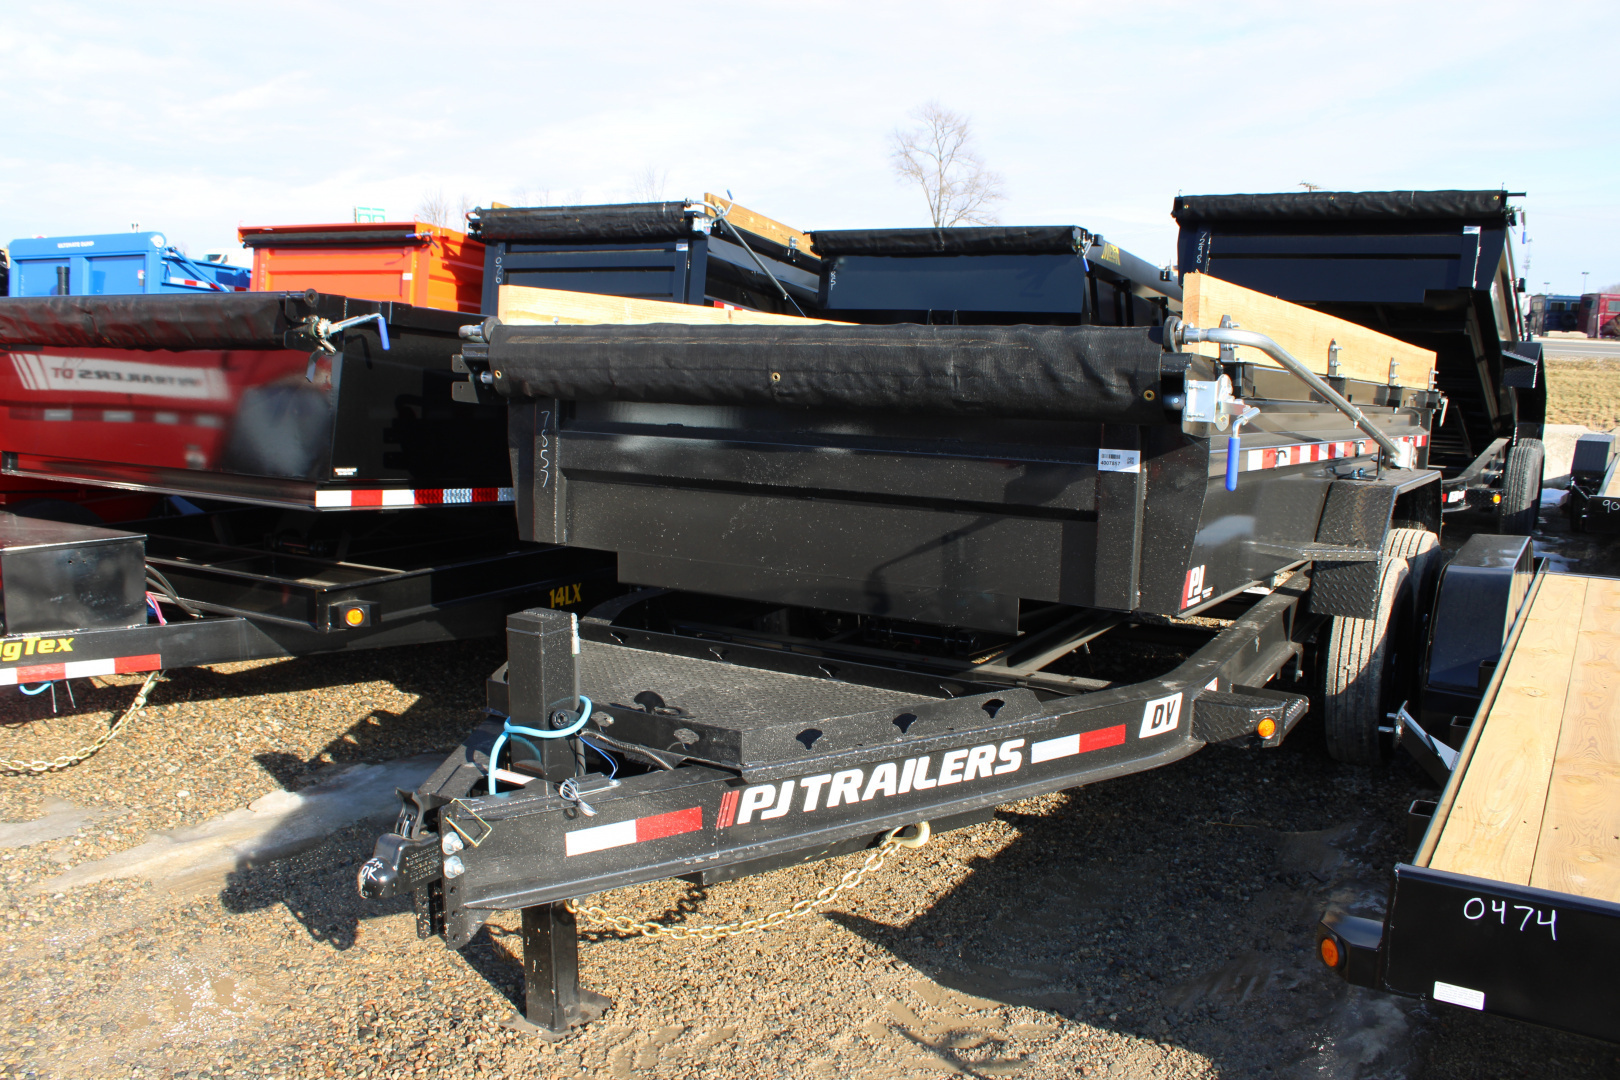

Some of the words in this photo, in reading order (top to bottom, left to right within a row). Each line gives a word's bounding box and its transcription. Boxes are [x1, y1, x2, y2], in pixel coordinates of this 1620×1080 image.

[540, 410, 551, 488] 7857
[549, 583, 582, 609] 14LX
[1187, 564, 1206, 599] PJ
[1150, 699, 1177, 730] DV
[737, 780, 795, 825] PJ
[800, 738, 1026, 813] TRAILERS
[1463, 897, 1558, 941] 0474
